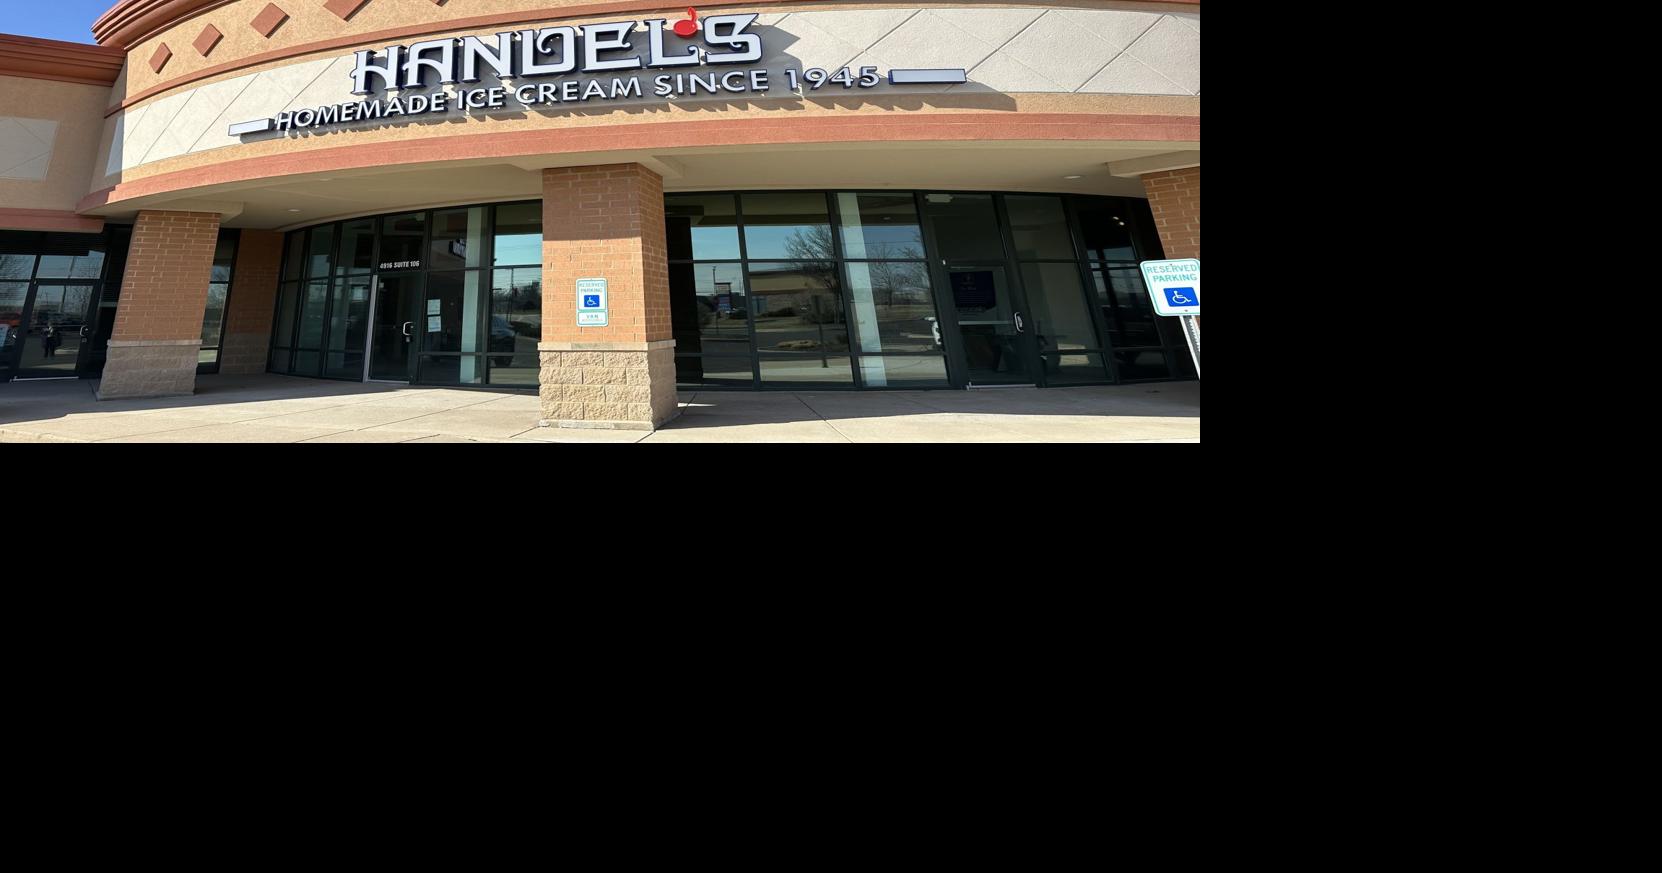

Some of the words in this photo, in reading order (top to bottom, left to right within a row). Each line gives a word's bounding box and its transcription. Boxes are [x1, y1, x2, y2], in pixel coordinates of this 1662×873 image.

[275, 92, 447, 131] HOMEMADE
[457, 86, 504, 110] ICE
[515, 77, 643, 105] CREAM
[654, 69, 770, 98] SINCE
[785, 66, 880, 91] 1945
[1146, 264, 1197, 273] RESERVED
[1152, 273, 1198, 282] PARKING
